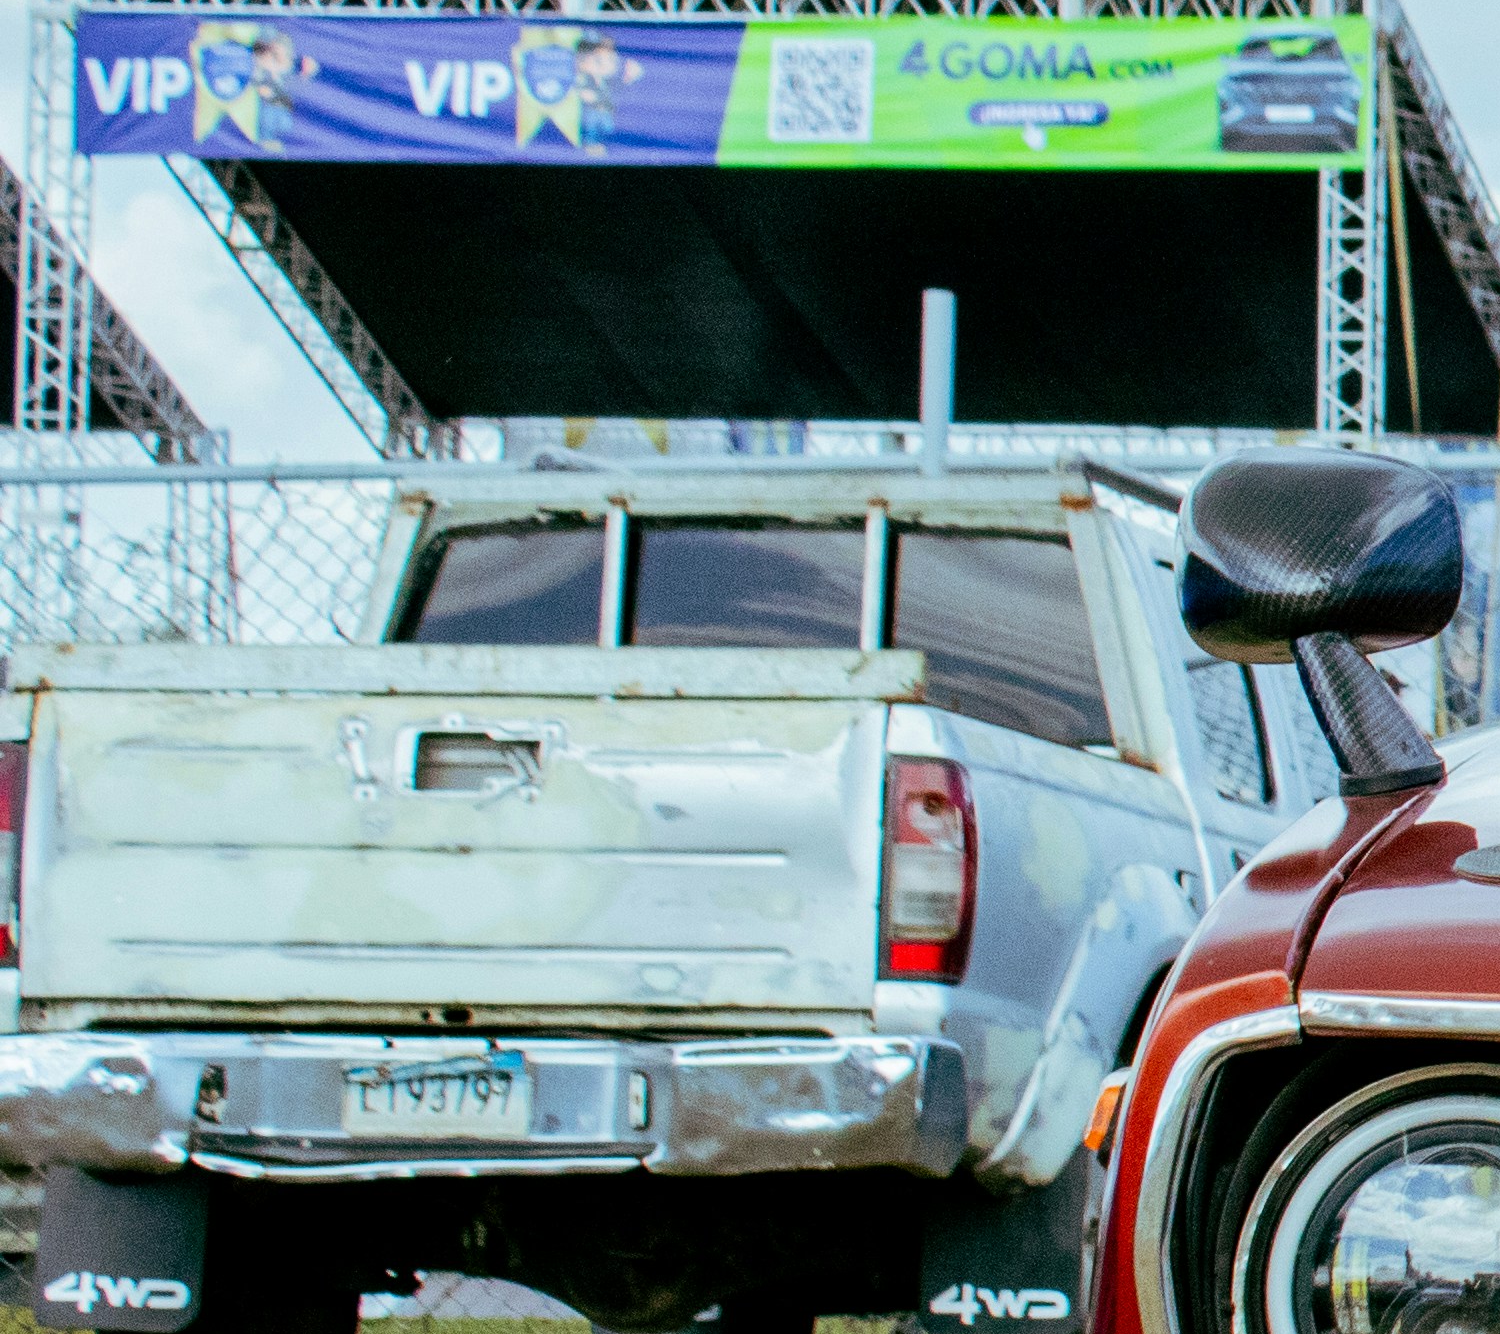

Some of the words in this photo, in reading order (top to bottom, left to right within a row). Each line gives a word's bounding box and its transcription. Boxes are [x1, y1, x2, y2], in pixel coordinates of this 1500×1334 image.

[83, 56, 193, 115] VIP
[404, 59, 515, 118] VIP
[44, 1271, 192, 1314] 4WD
[929, 1282, 1071, 1326] 4WD
